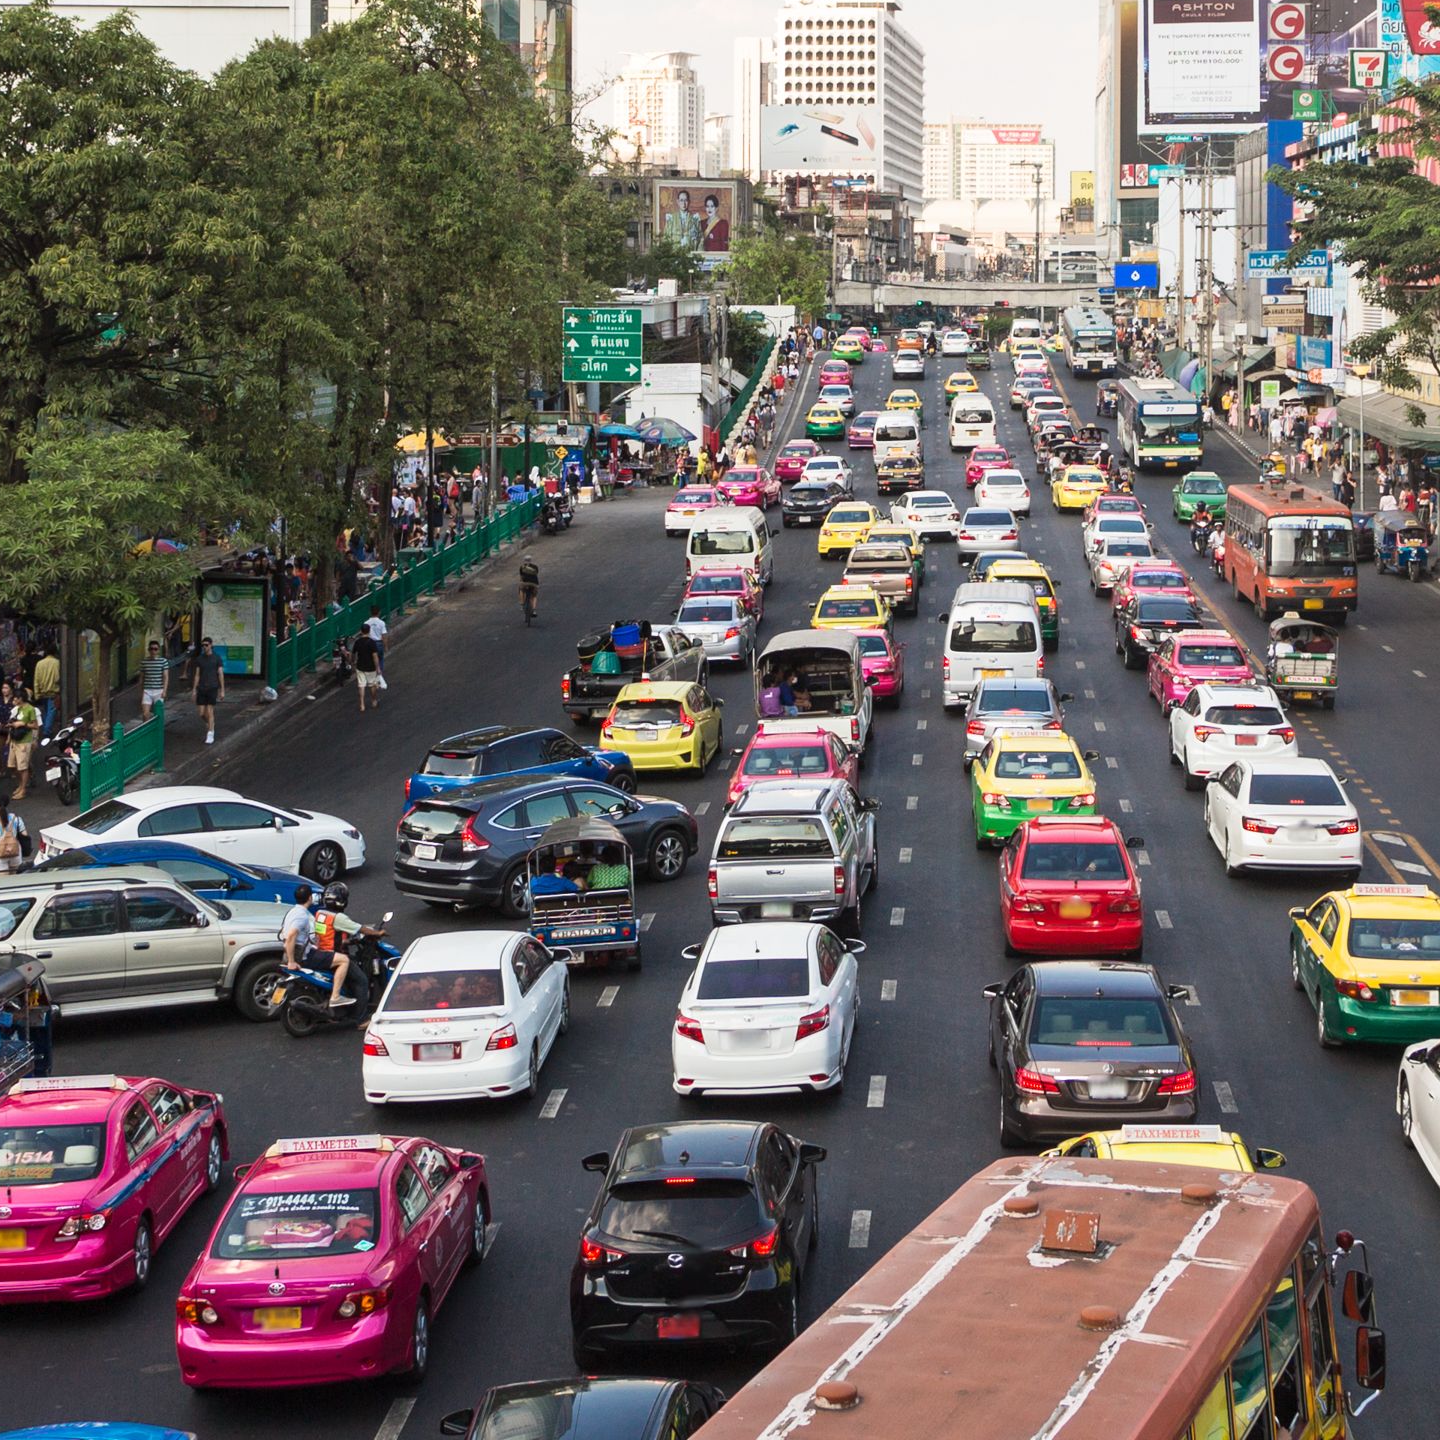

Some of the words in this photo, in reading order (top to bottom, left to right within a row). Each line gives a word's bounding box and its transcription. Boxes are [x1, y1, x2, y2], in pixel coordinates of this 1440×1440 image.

[1171, 3, 1235, 12] ASHTON
[1357, 70, 1381, 78] ELEVEN
[591, 335, 630, 347] ดินแดง
[580, 357, 608, 371] อโศก
[1306, 519, 1318, 530] 77
[1343, 566, 1354, 576] 77
[554, 926, 613, 938] THAILAND
[1134, 1128, 1201, 1139] TAXI-METER
[292, 1138, 358, 1150] TAXI-METER
[326, 1193, 350, 1206] 1113
